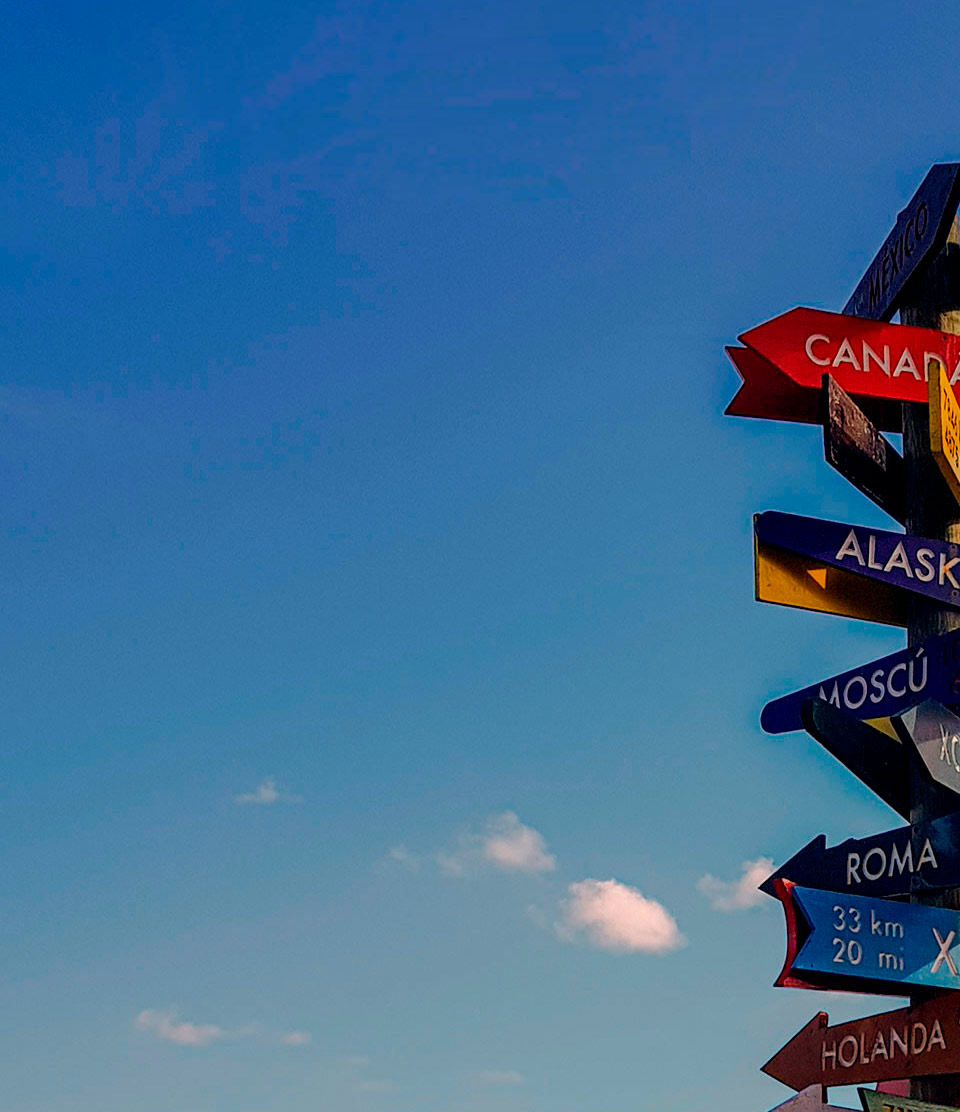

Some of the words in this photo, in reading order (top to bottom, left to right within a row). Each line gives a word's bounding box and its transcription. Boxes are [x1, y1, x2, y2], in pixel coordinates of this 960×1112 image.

[868, 202, 928, 312] MÉXICO
[819, 648, 928, 710] MOSCÚ
[845, 838, 938, 884] ROMA
[832, 906, 861, 932] 33
[872, 910, 904, 938] km
[832, 940, 861, 964] 20
[879, 949, 904, 971] mi
[822, 1019, 946, 1071] HOLANDA
